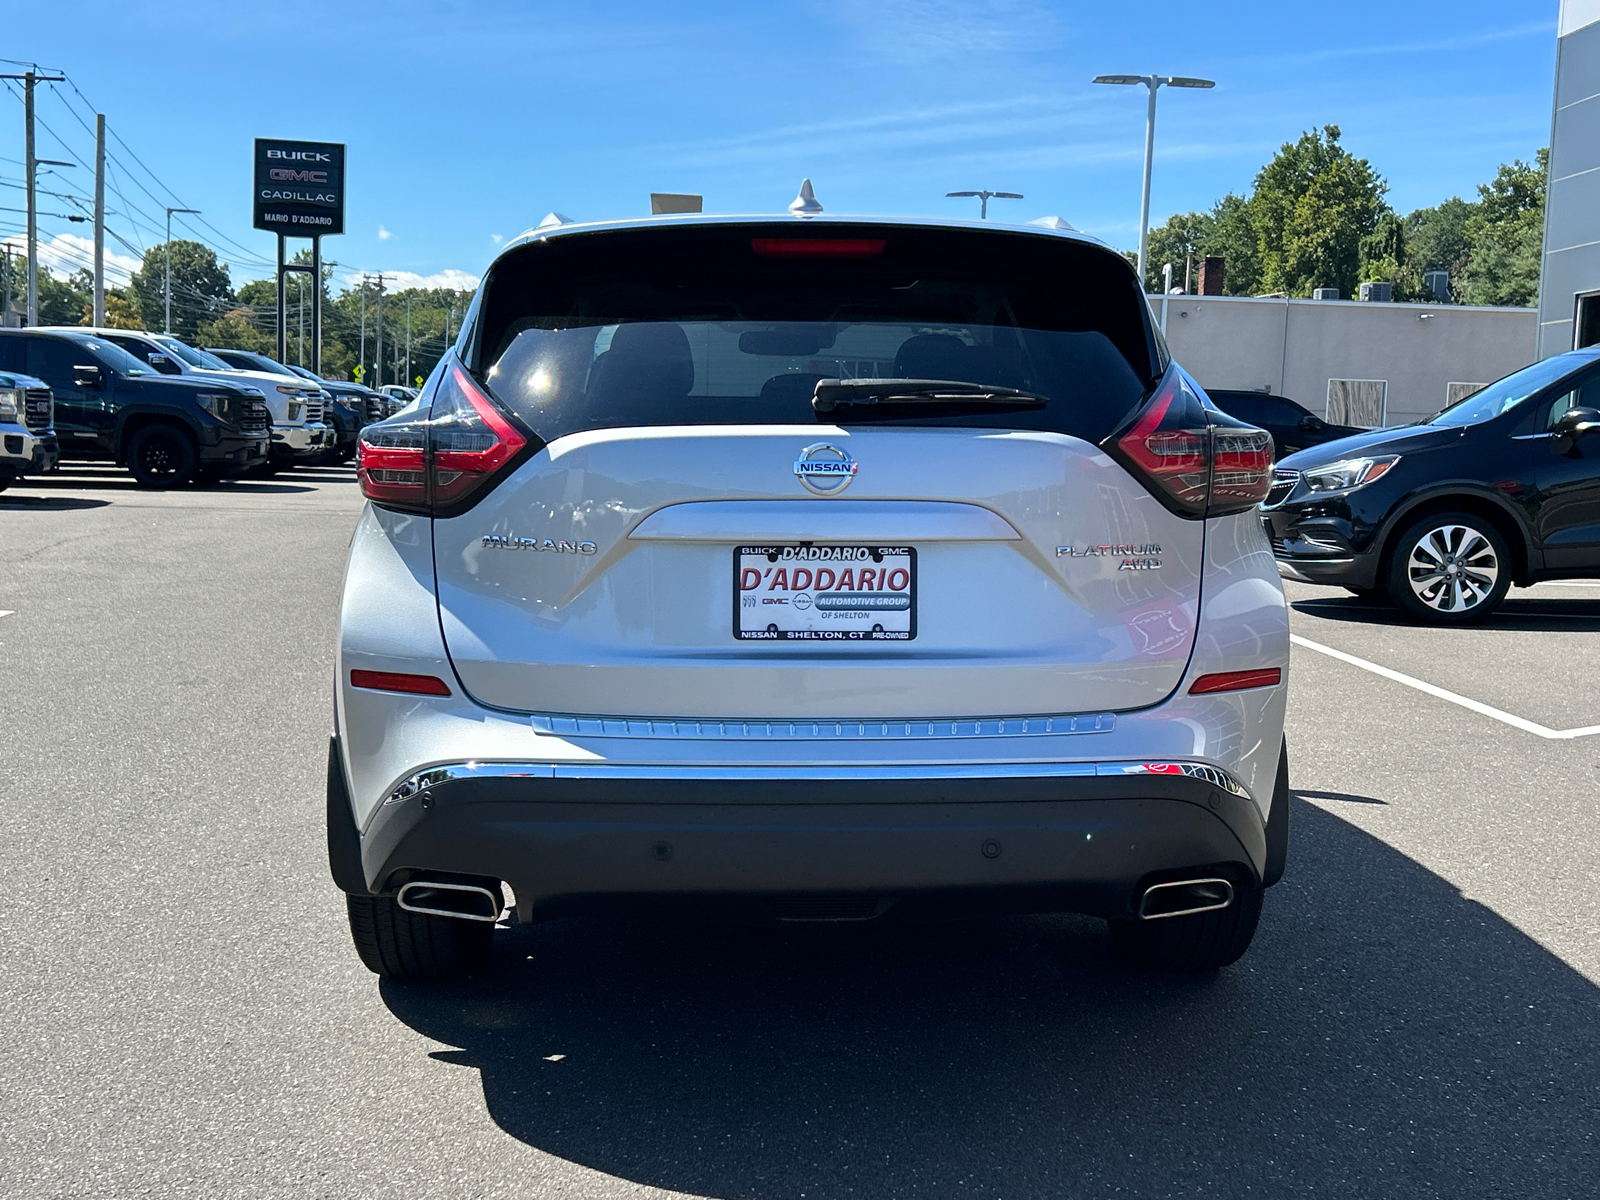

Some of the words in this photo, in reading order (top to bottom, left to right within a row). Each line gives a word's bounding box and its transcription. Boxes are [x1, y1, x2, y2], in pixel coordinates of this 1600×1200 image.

[266, 149, 331, 162] BUICK
[269, 168, 328, 183] GMC
[261, 190, 336, 202] CADILLAC
[264, 213, 289, 223] MARIO
[292, 214, 332, 226] D'ADDARIO
[800, 463, 851, 472] NISSAN
[481, 534, 598, 556] MURANO
[741, 547, 777, 555] BUICK
[1055, 543, 1162, 558] PLATINUM
[782, 547, 870, 561] D'ADDARIO
[1118, 558, 1163, 571] AWD
[740, 567, 910, 591] D'ADDARIO
[819, 597, 875, 606] AUTOMOTIVE
[876, 597, 907, 606] GROUP
[787, 631, 846, 639] SHELTON,
